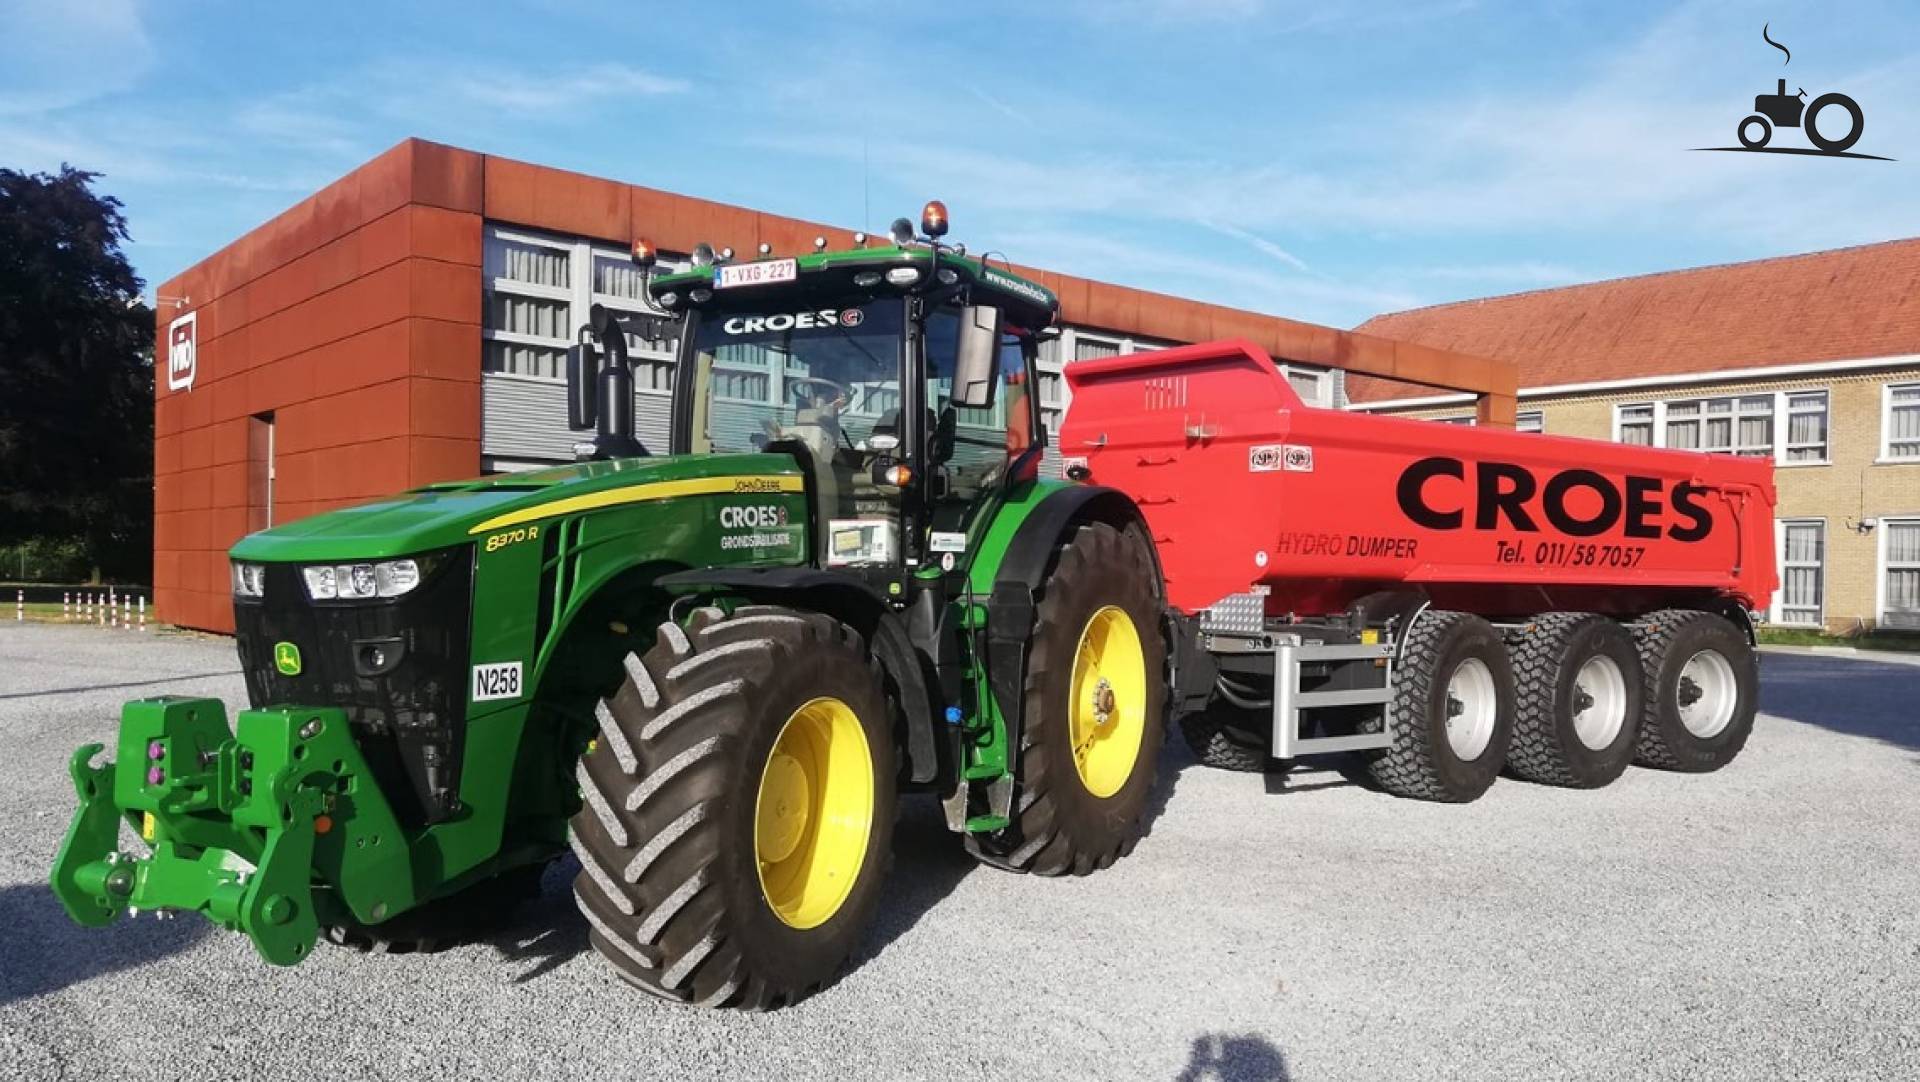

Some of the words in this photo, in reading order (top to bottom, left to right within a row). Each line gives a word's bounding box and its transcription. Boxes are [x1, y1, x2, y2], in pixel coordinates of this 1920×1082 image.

[723, 309, 838, 335] CROES
[1396, 457, 1713, 542] CROES
[720, 505, 778, 529] CROES
[486, 529, 524, 552] 8370
[1276, 532, 1342, 556] HYDRO
[1346, 535, 1418, 558] DUMPER
[1496, 540, 1525, 563] Tel.
[477, 667, 518, 696] N258
